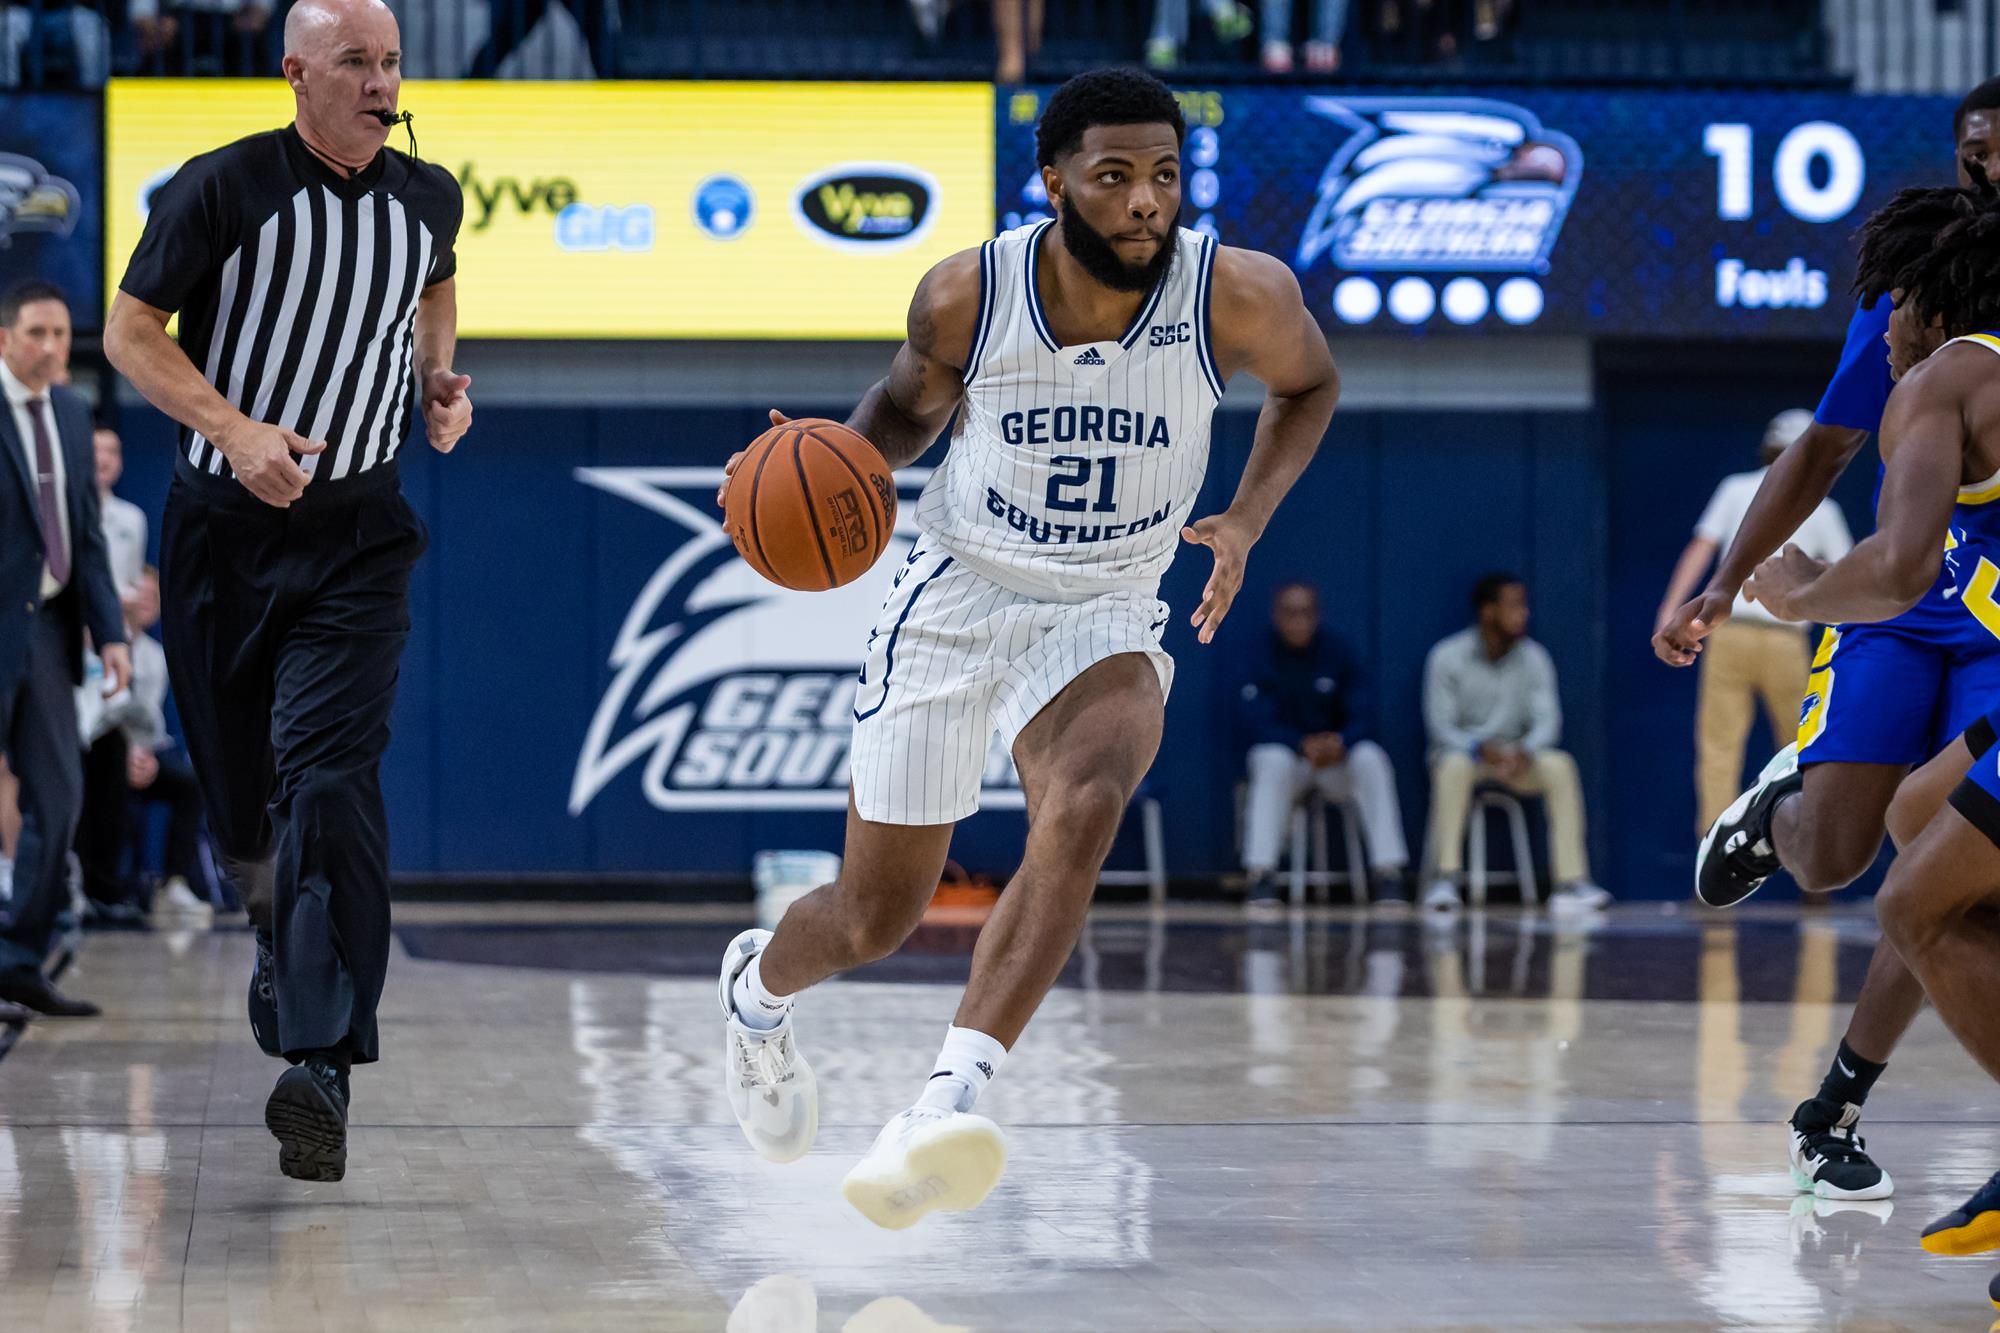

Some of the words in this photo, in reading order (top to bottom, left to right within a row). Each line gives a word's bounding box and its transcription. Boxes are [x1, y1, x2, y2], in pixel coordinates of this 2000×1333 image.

[1704, 120, 1866, 223] 10
[556, 203, 655, 251] GIG
[1716, 256, 1829, 309] Fouls
[1150, 322, 1191, 347] SBC
[1073, 357, 1106, 366] adidas
[1001, 405, 1170, 448] GEORGIA
[1045, 455, 1117, 512] 21
[836, 486, 868, 553] PRO
